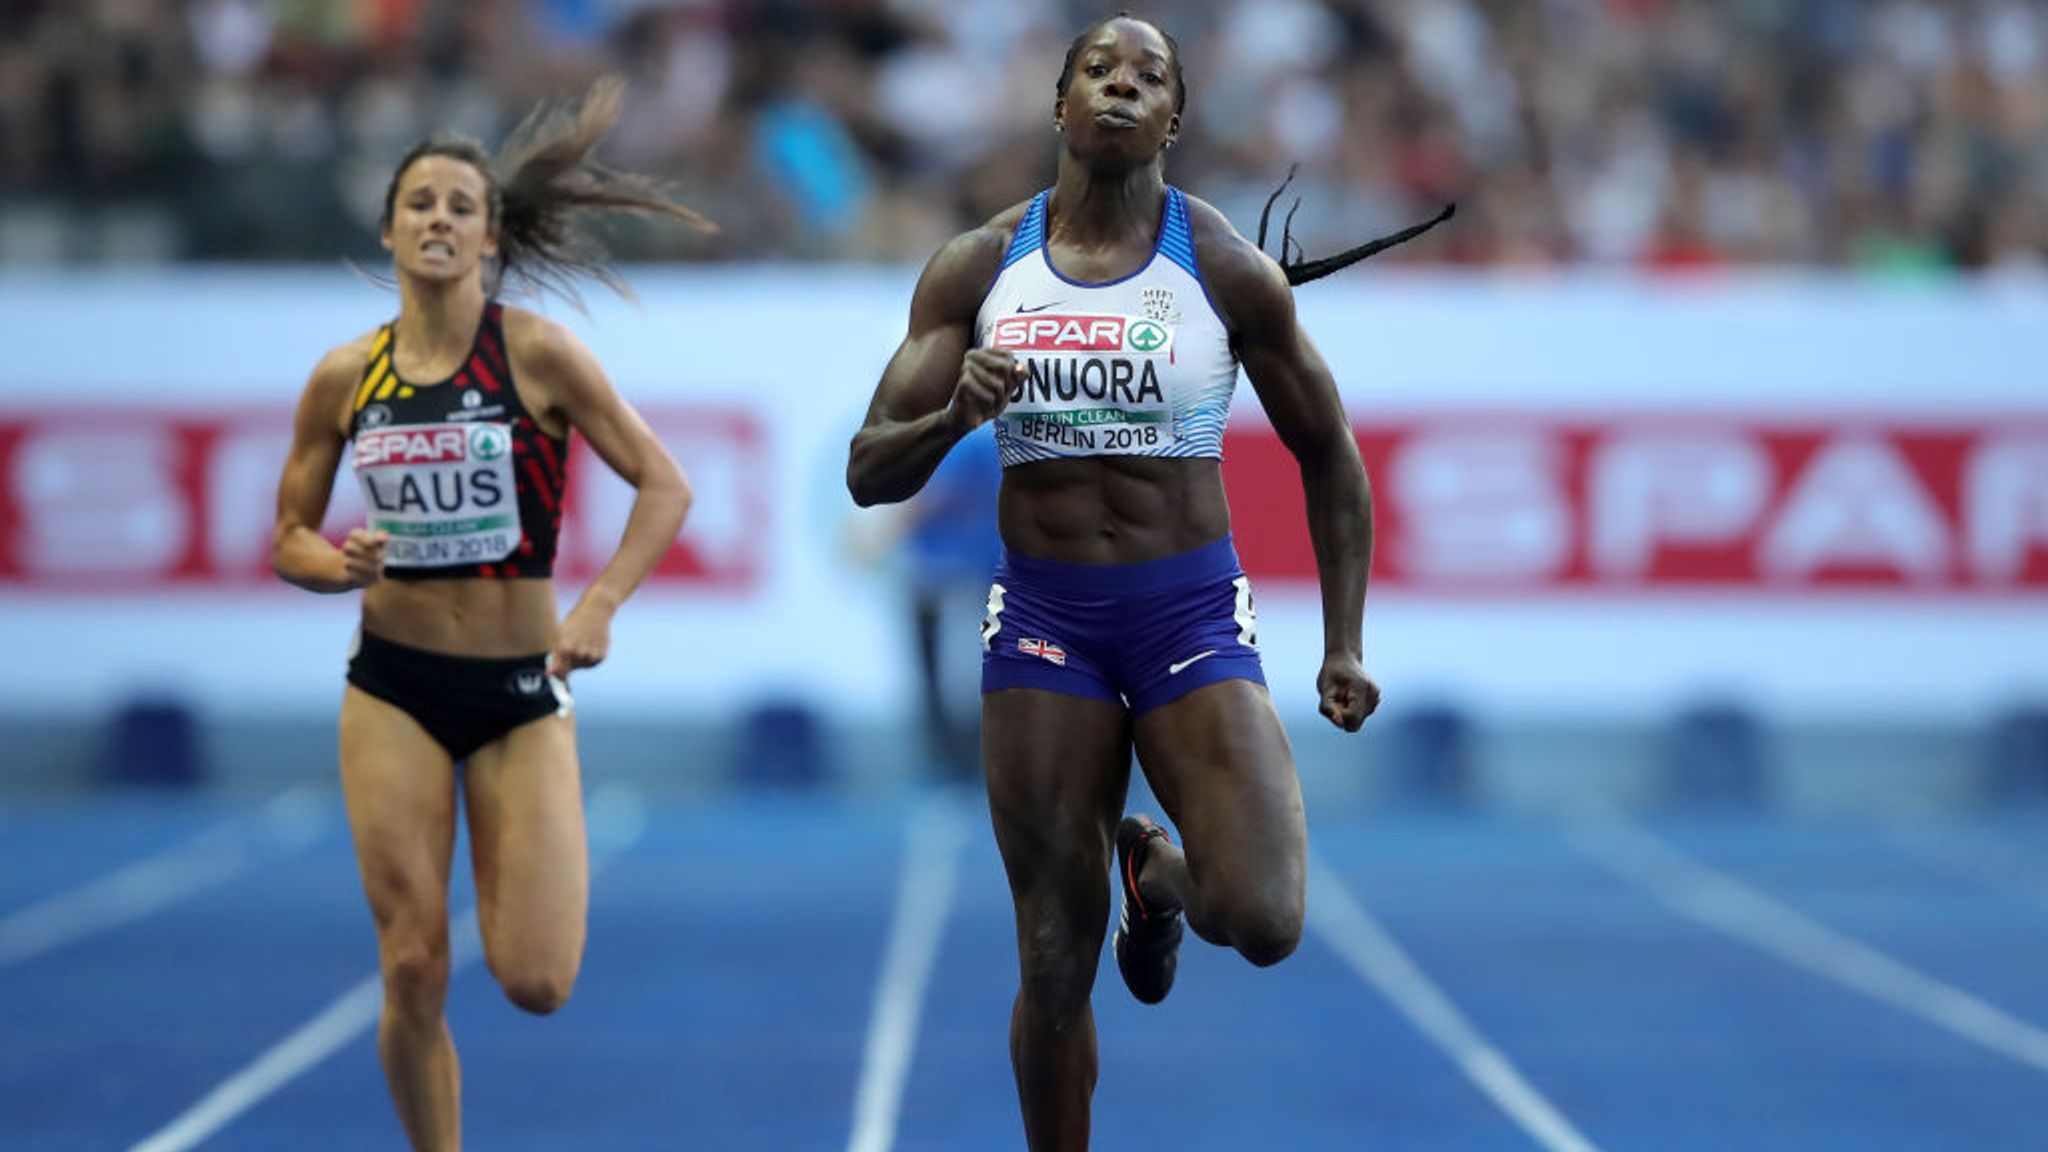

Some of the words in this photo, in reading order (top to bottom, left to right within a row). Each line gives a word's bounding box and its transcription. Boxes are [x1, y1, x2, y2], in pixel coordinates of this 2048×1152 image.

[998, 319, 1122, 346] SPAR
[1077, 410, 1126, 424] CLEAN
[1021, 420, 1095, 449] BERLIN
[1104, 426, 1158, 449] 2018
[355, 433, 463, 467] SPAR
[367, 469, 503, 513] LAUS
[384, 539, 450, 562] ERLIN
